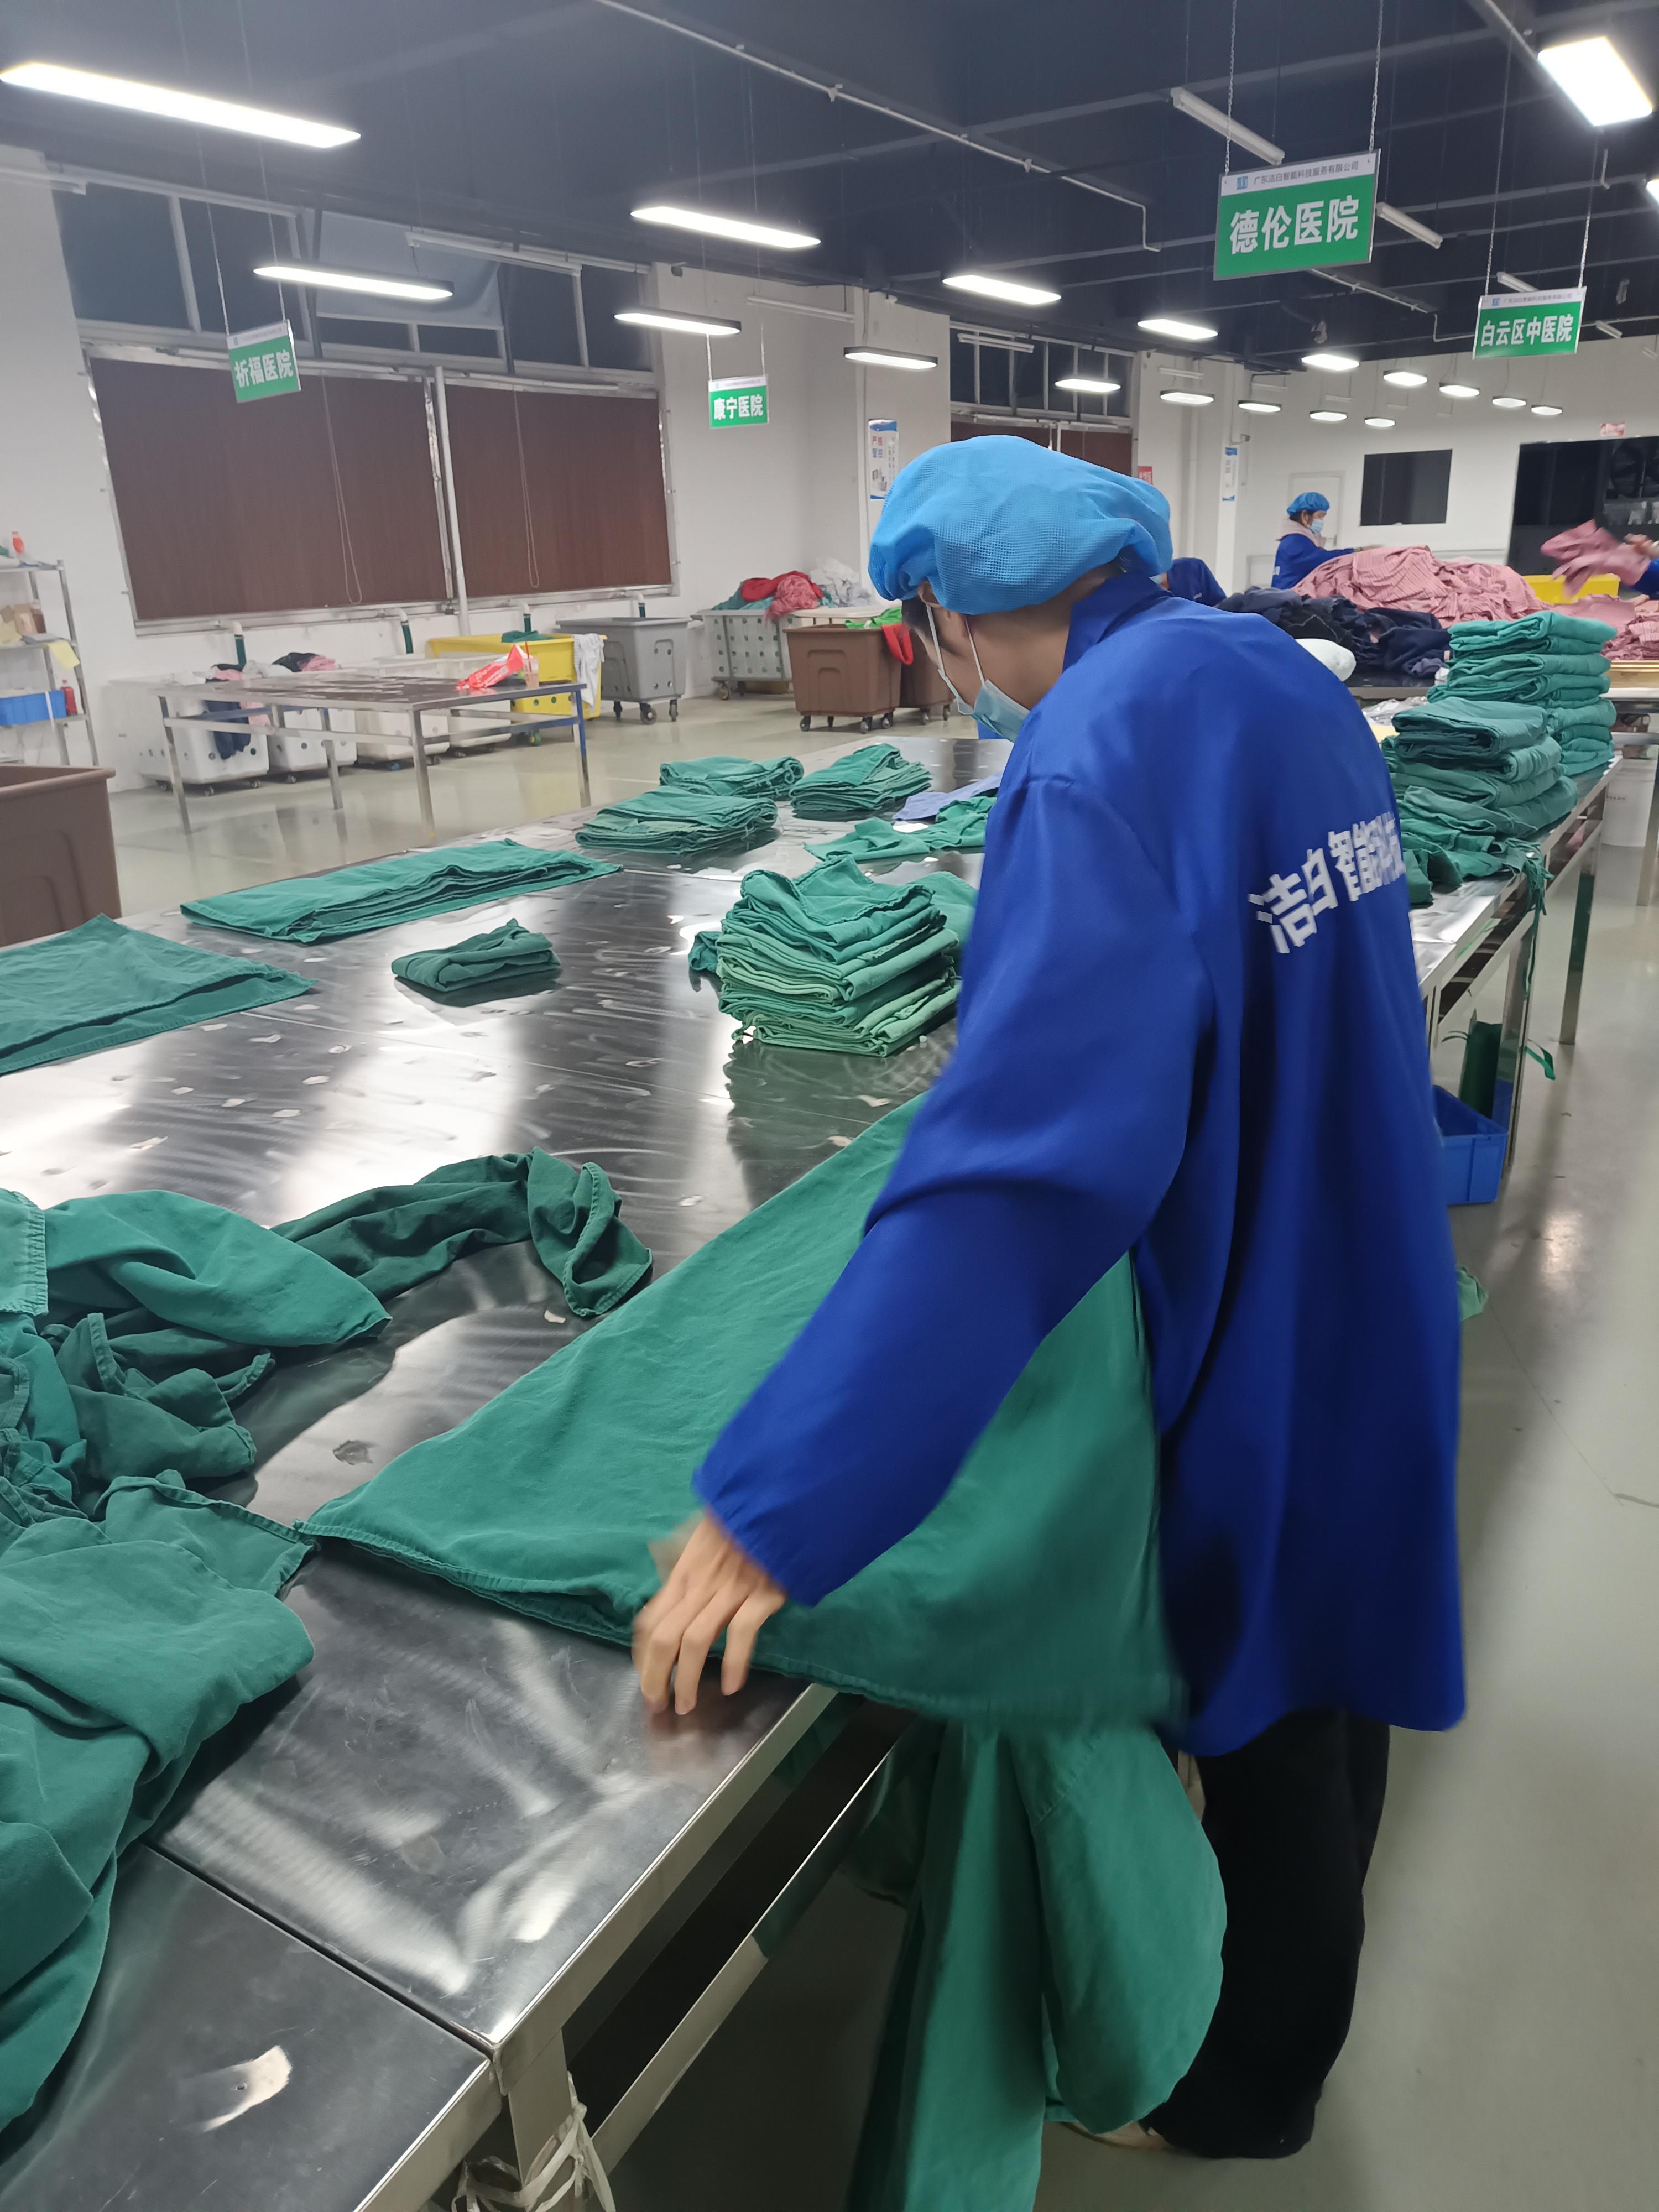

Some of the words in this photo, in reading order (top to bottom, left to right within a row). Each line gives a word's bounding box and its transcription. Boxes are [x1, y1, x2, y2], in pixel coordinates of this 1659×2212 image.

[1254, 160, 1359, 185] 广东洁白智能科技服务有限公司
[1229, 195, 1360, 255] 德伦医院
[1480, 313, 1574, 347] 白云区中医院
[234, 349, 294, 388] 祈福医院
[713, 393, 764, 421] 康宁医院
